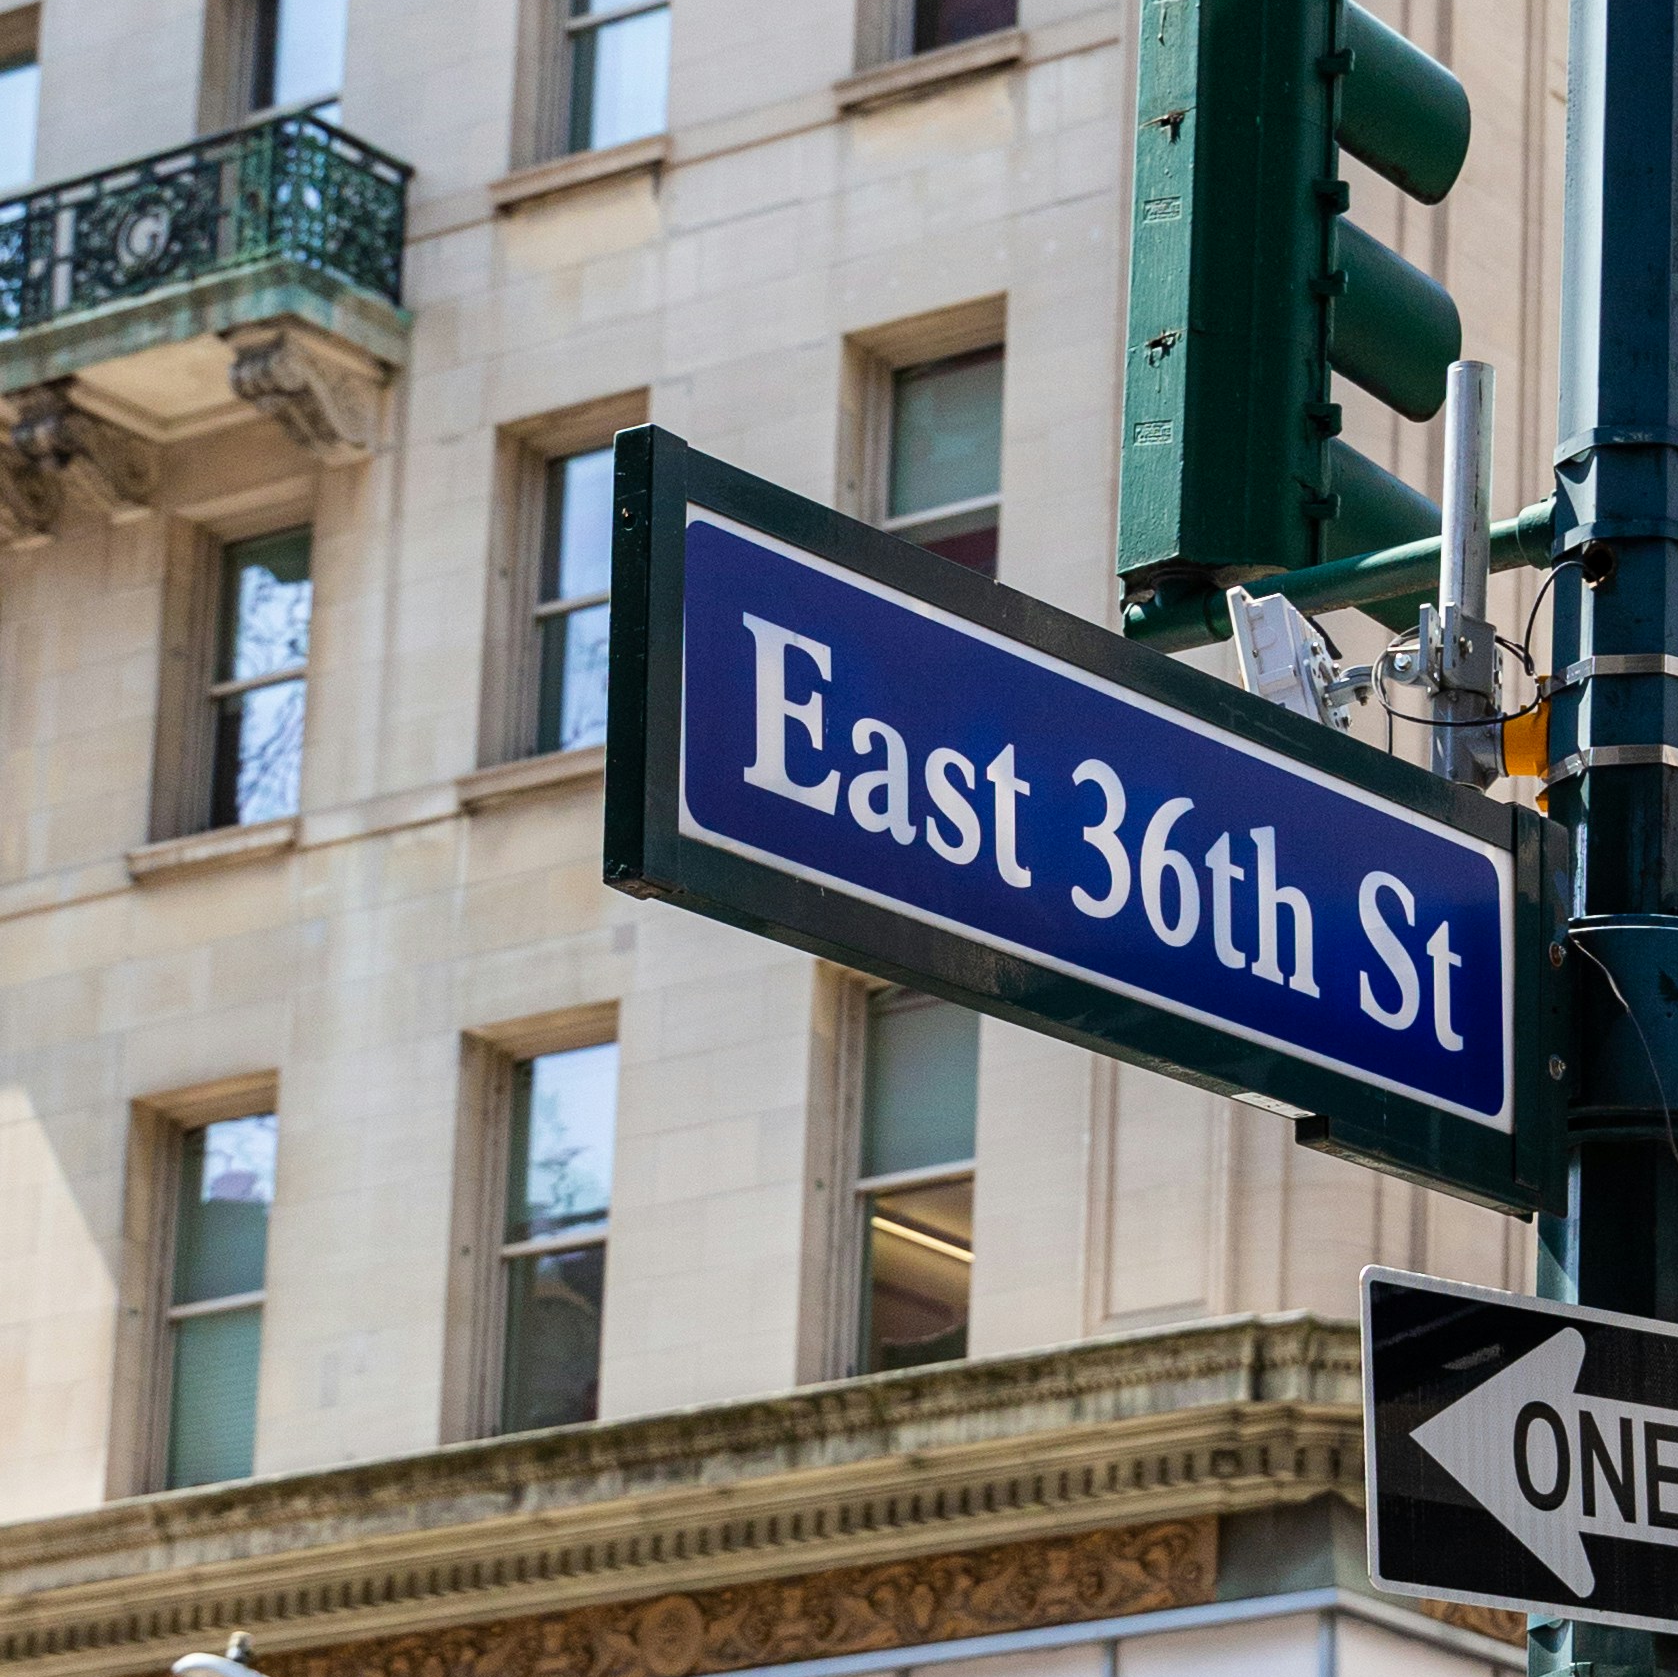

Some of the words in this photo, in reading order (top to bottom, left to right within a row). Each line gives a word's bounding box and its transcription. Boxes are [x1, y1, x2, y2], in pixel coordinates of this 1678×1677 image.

[742, 612, 1033, 888] East
[1071, 759, 1320, 999] 36th
[1358, 870, 1464, 1052] St
